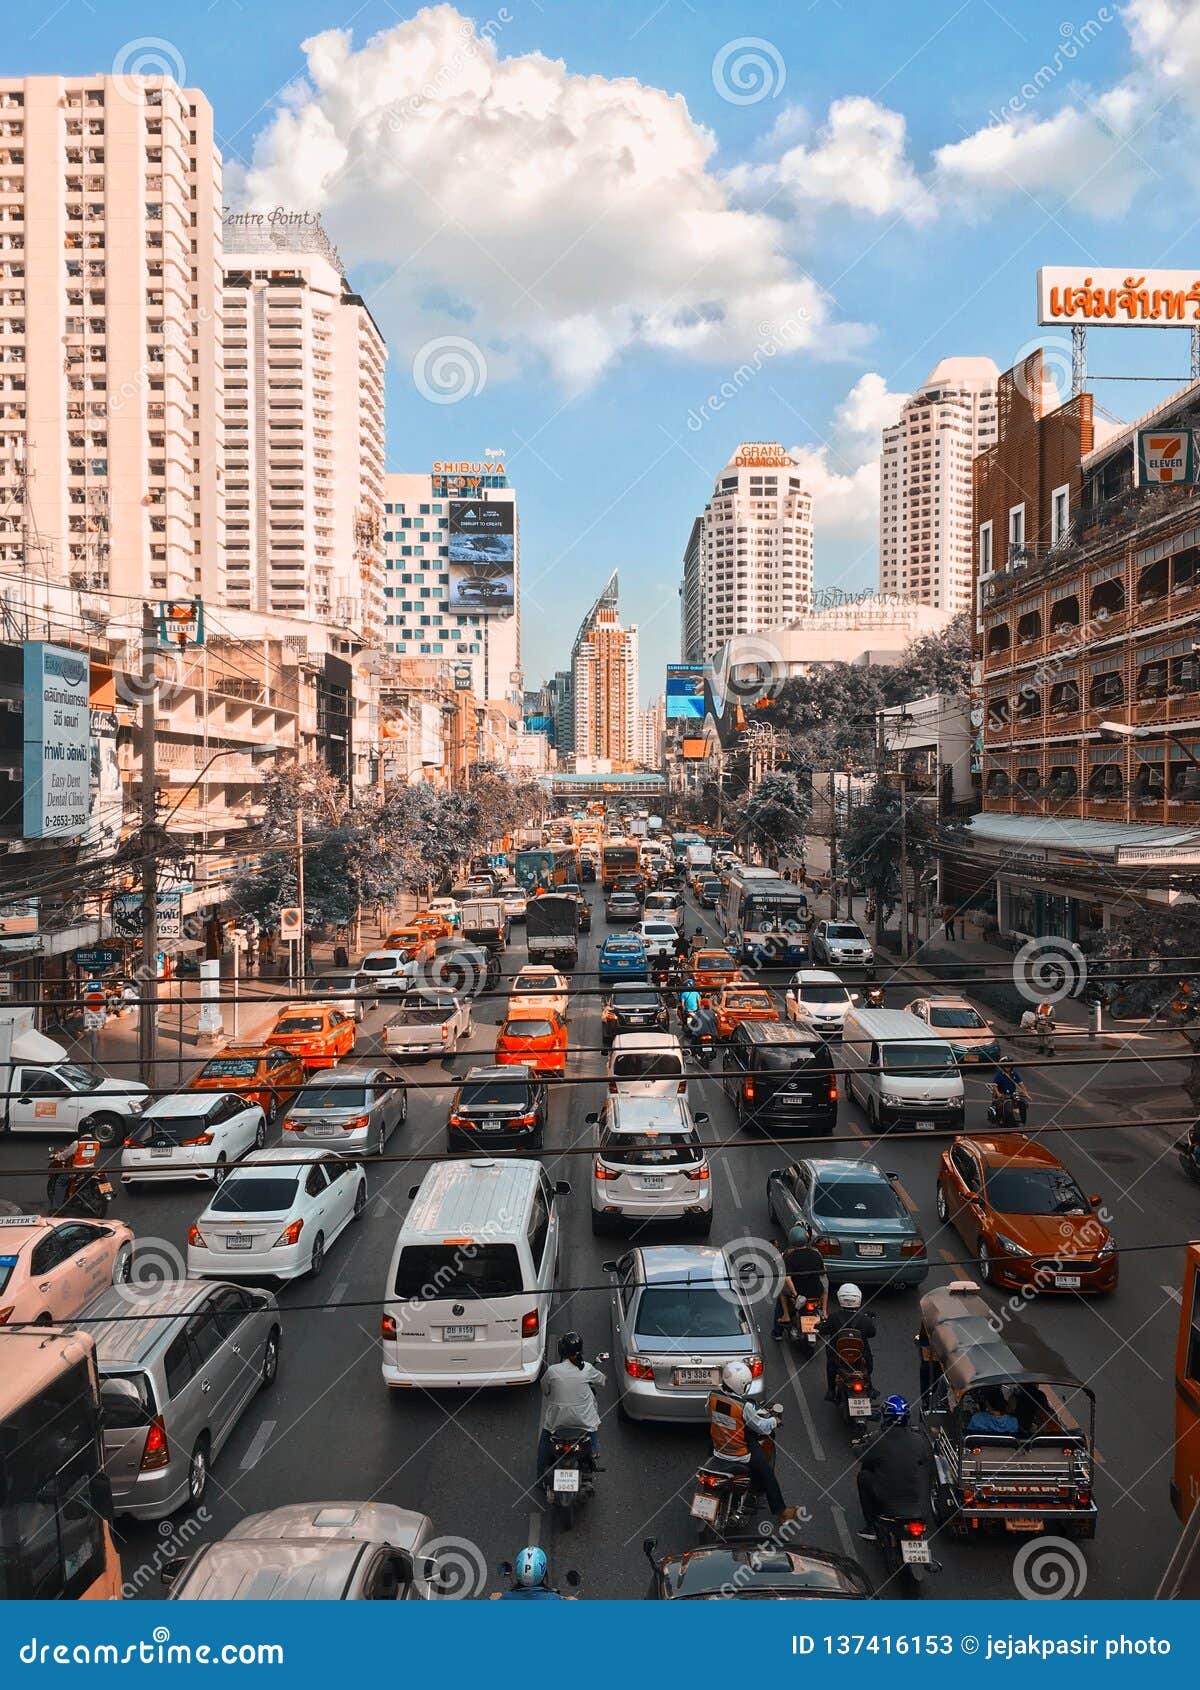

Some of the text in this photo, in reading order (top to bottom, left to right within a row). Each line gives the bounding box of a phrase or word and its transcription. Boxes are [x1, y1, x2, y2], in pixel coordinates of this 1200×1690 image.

[267, 206, 316, 225] Point
[741, 446, 786, 457] GRAND
[433, 462, 505, 474] SHIBUYA
[735, 457, 792, 468] DIAMOND
[104, 953, 112, 961] 13
